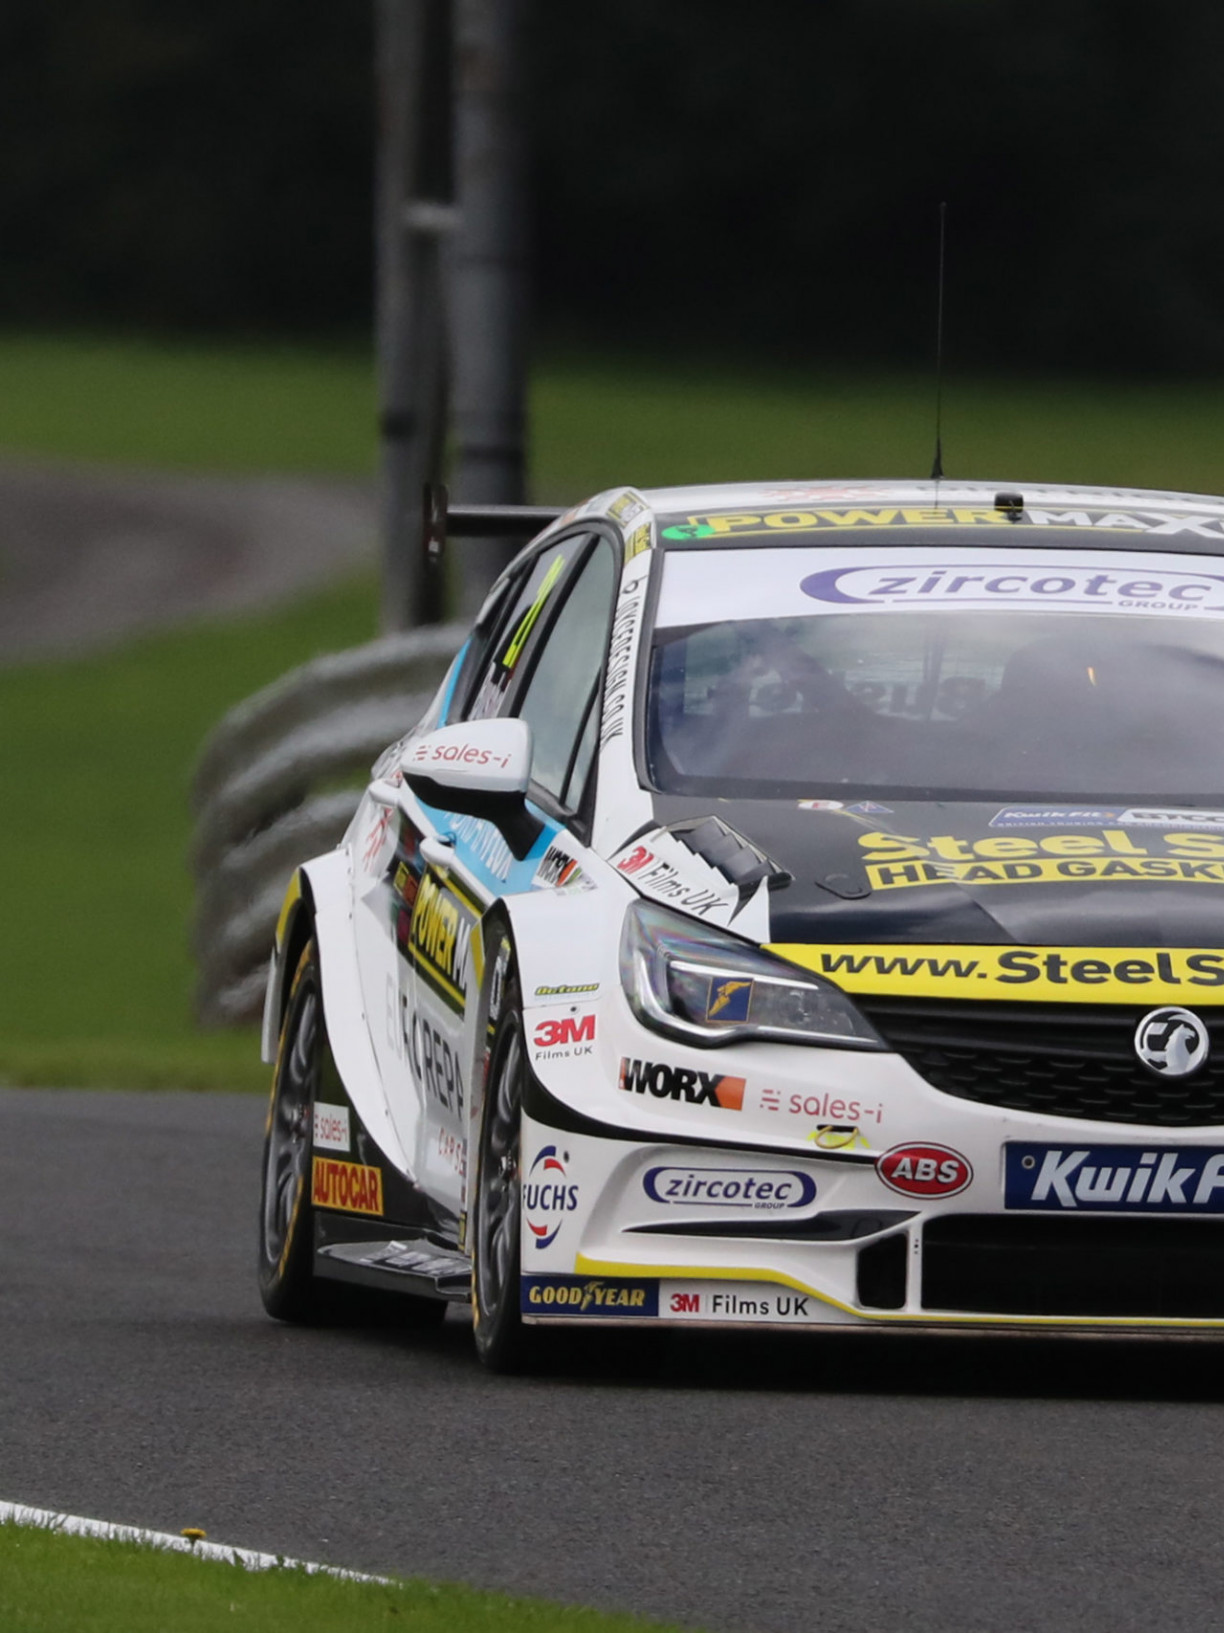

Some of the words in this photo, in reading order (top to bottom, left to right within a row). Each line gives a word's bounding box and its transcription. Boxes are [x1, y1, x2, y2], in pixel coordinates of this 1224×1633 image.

[868, 570, 1214, 602] zircotec
[1117, 600, 1198, 612] GROUP
[431, 743, 512, 769] sales-i
[857, 830, 1149, 861] Steel
[878, 861, 1043, 886] HEAD
[638, 862, 691, 898] Films
[681, 889, 729, 916] UK
[533, 1014, 596, 1048] 3M
[535, 1050, 570, 1061] Films
[574, 1045, 593, 1057] UK
[621, 1057, 727, 1108] WORX
[789, 1092, 883, 1124] sales-i
[891, 1156, 961, 1185] ABS
[313, 1161, 380, 1212] AUTOCAR
[664, 1173, 792, 1202] zircotec
[753, 1202, 785, 1210] GROUP
[670, 1292, 700, 1314] 3M
[711, 1294, 770, 1316] Films
[776, 1296, 809, 1317] UK
